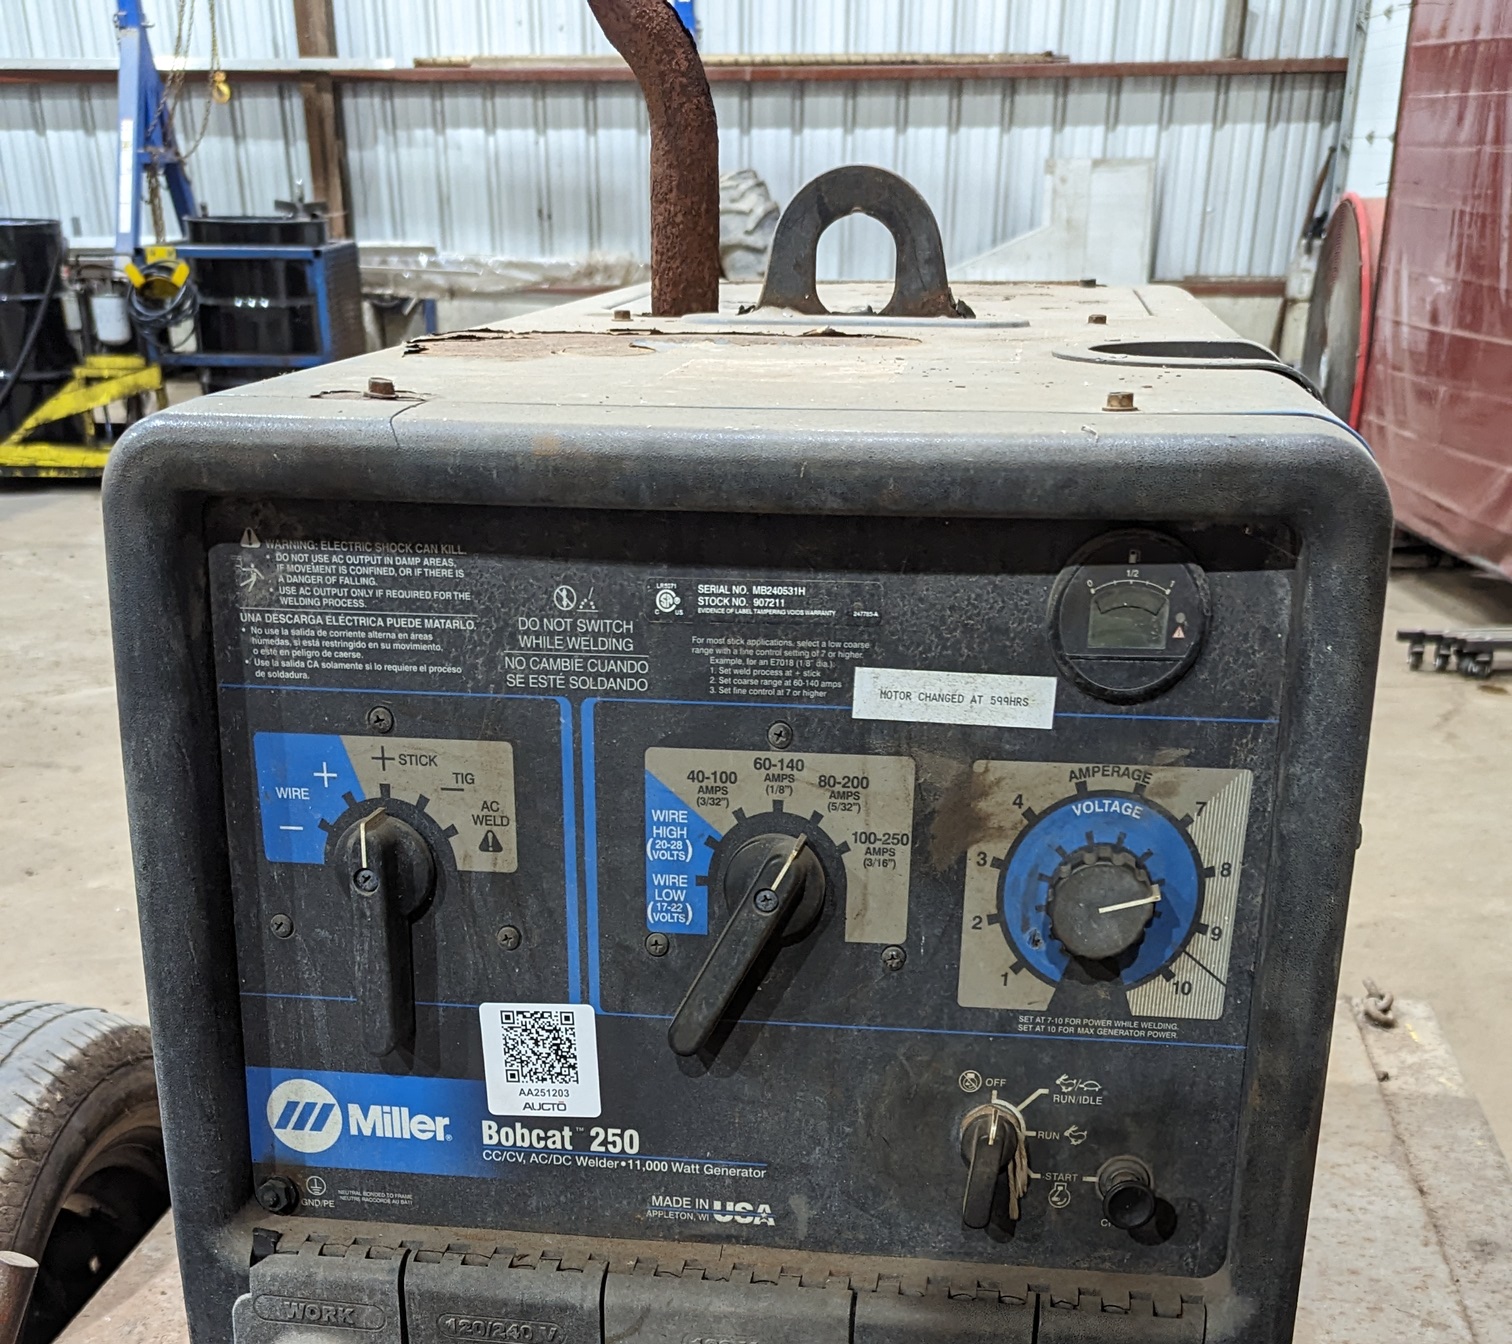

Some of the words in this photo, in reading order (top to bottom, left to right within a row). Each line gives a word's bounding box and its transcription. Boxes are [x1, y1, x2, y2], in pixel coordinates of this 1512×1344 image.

[265, 539, 318, 550] WARNING:
[321, 540, 372, 552] ELECTRIC
[375, 542, 413, 553] SHOCK
[415, 543, 438, 554] CAN
[276, 553, 289, 561] DO
[291, 554, 308, 562] NOT
[311, 554, 329, 563] USE
[332, 555, 343, 563] AC
[346, 555, 382, 564] OUTPUT
[384, 557, 393, 565] IN
[395, 557, 421, 566] DAMP
[339, 566, 347, 574] IS
[399, 567, 412, 576] OR
[414, 568, 422, 576] IF
[424, 568, 453, 577] THERE
[455, 569, 464, 578] IS
[1126, 569, 1139, 578] 1/2
[286, 575, 323, 584] DANGER
[325, 576, 337, 584] OF
[279, 586, 296, 595] USE
[299, 587, 311, 595] AC
[313, 587, 348, 596] OUTPUT
[351, 588, 373, 597] ONLY
[375, 589, 383, 598] IF
[386, 590, 431, 599] REQUIRED
[433, 591, 451, 600] FOR
[453, 591, 471, 600] THE
[697, 584, 730, 594] SERIAL
[732, 585, 749, 594] NO.
[280, 597, 320, 606] WELDING
[697, 596, 731, 606] STOCK
[732, 597, 749, 606] NO.
[753, 598, 784, 607] 907211
[240, 612, 262, 623] UNA
[265, 613, 323, 624] DESCARGA
[387, 617, 422, 628] PUEDE
[424, 618, 477, 630] MATARLO.
[518, 617, 540, 630] DO
[544, 618, 573, 631] NOT
[577, 619, 634, 633] SWITCH
[519, 635, 564, 649] WHILE
[567, 637, 634, 651] WELDING
[505, 656, 526, 669] NO
[529, 657, 584, 671] CAMBIE
[587, 658, 649, 674] CUANDO
[506, 673, 525, 687] SE
[569, 675, 648, 691] SOLDANDO
[718, 686, 731, 694] Set
[748, 688, 775, 696] control
[802, 689, 827, 698] higher
[879, 690, 912, 701] MOTOR
[918, 692, 964, 704] CHANGED
[970, 695, 984, 704] AT
[990, 695, 1029, 707] 599HRS
[398, 753, 438, 767] STICK
[753, 757, 805, 772] 60-140
[452, 772, 475, 785] TIG
[687, 770, 738, 785] 40-100
[763, 773, 796, 784] AMPS
[1068, 765, 1153, 784] AMPERAGE
[818, 775, 870, 790] 80-200
[275, 786, 311, 800] WIRE
[697, 785, 729, 796] AMPS
[828, 791, 861, 801] AMPS
[481, 800, 500, 812] AC
[1012, 794, 1023, 808] 4
[1071, 800, 1143, 819] VOLTAGE
[1195, 801, 1207, 816] 7
[471, 814, 510, 827] WELD
[651, 809, 688, 823] WIRE
[652, 825, 687, 839] HIGH
[852, 831, 910, 847] 100-250
[864, 847, 896, 857] AMPS
[976, 852, 987, 867] 3
[1220, 862, 1231, 877] 8
[652, 873, 688, 887] WIRE
[654, 889, 686, 901] LOW
[971, 915, 983, 930] 2
[1211, 927, 1222, 941] 9
[1000, 972, 1008, 986] 1
[1172, 981, 1191, 996] 10
[1018, 1015, 1033, 1023] SET
[1035, 1016, 1046, 1024] AT
[1047, 1017, 1063, 1025] 7-10
[1083, 1018, 1112, 1027] POWER
[1114, 1020, 1139, 1028] WHILE
[1018, 1024, 1033, 1032] SET
[1035, 1025, 1046, 1033] AT
[1058, 1026, 1075, 1034] FOR
[1077, 1027, 1094, 1035] MAX
[1096, 1028, 1145, 1038] GENERATOR
[985, 1078, 1007, 1087] OFF
[518, 1088, 570, 1098] AA251203
[1052, 1094, 1103, 1105] RUN/IDLE
[522, 1101, 567, 1112] AUCTO
[347, 1103, 450, 1142] Miller
[481, 1120, 573, 1151] Bobcat
[589, 1126, 640, 1154] 250
[1037, 1130, 1060, 1141] RUN
[482, 1150, 526, 1164] CC/CV,
[529, 1152, 572, 1166] AC/DC
[671, 1161, 700, 1174] Watt
[703, 1164, 767, 1178] Generator
[1045, 1172, 1078, 1182] START
[301, 1198, 335, 1208] GND/PE
[645, 1209, 696, 1221] APPLETON,
[698, 1212, 710, 1222] WI
[651, 1195, 692, 1209] MADE
[695, 1198, 709, 1210] IN
[713, 1200, 776, 1226] USA
[283, 1301, 356, 1324] WORK
[445, 1318, 534, 1340] 120/240
